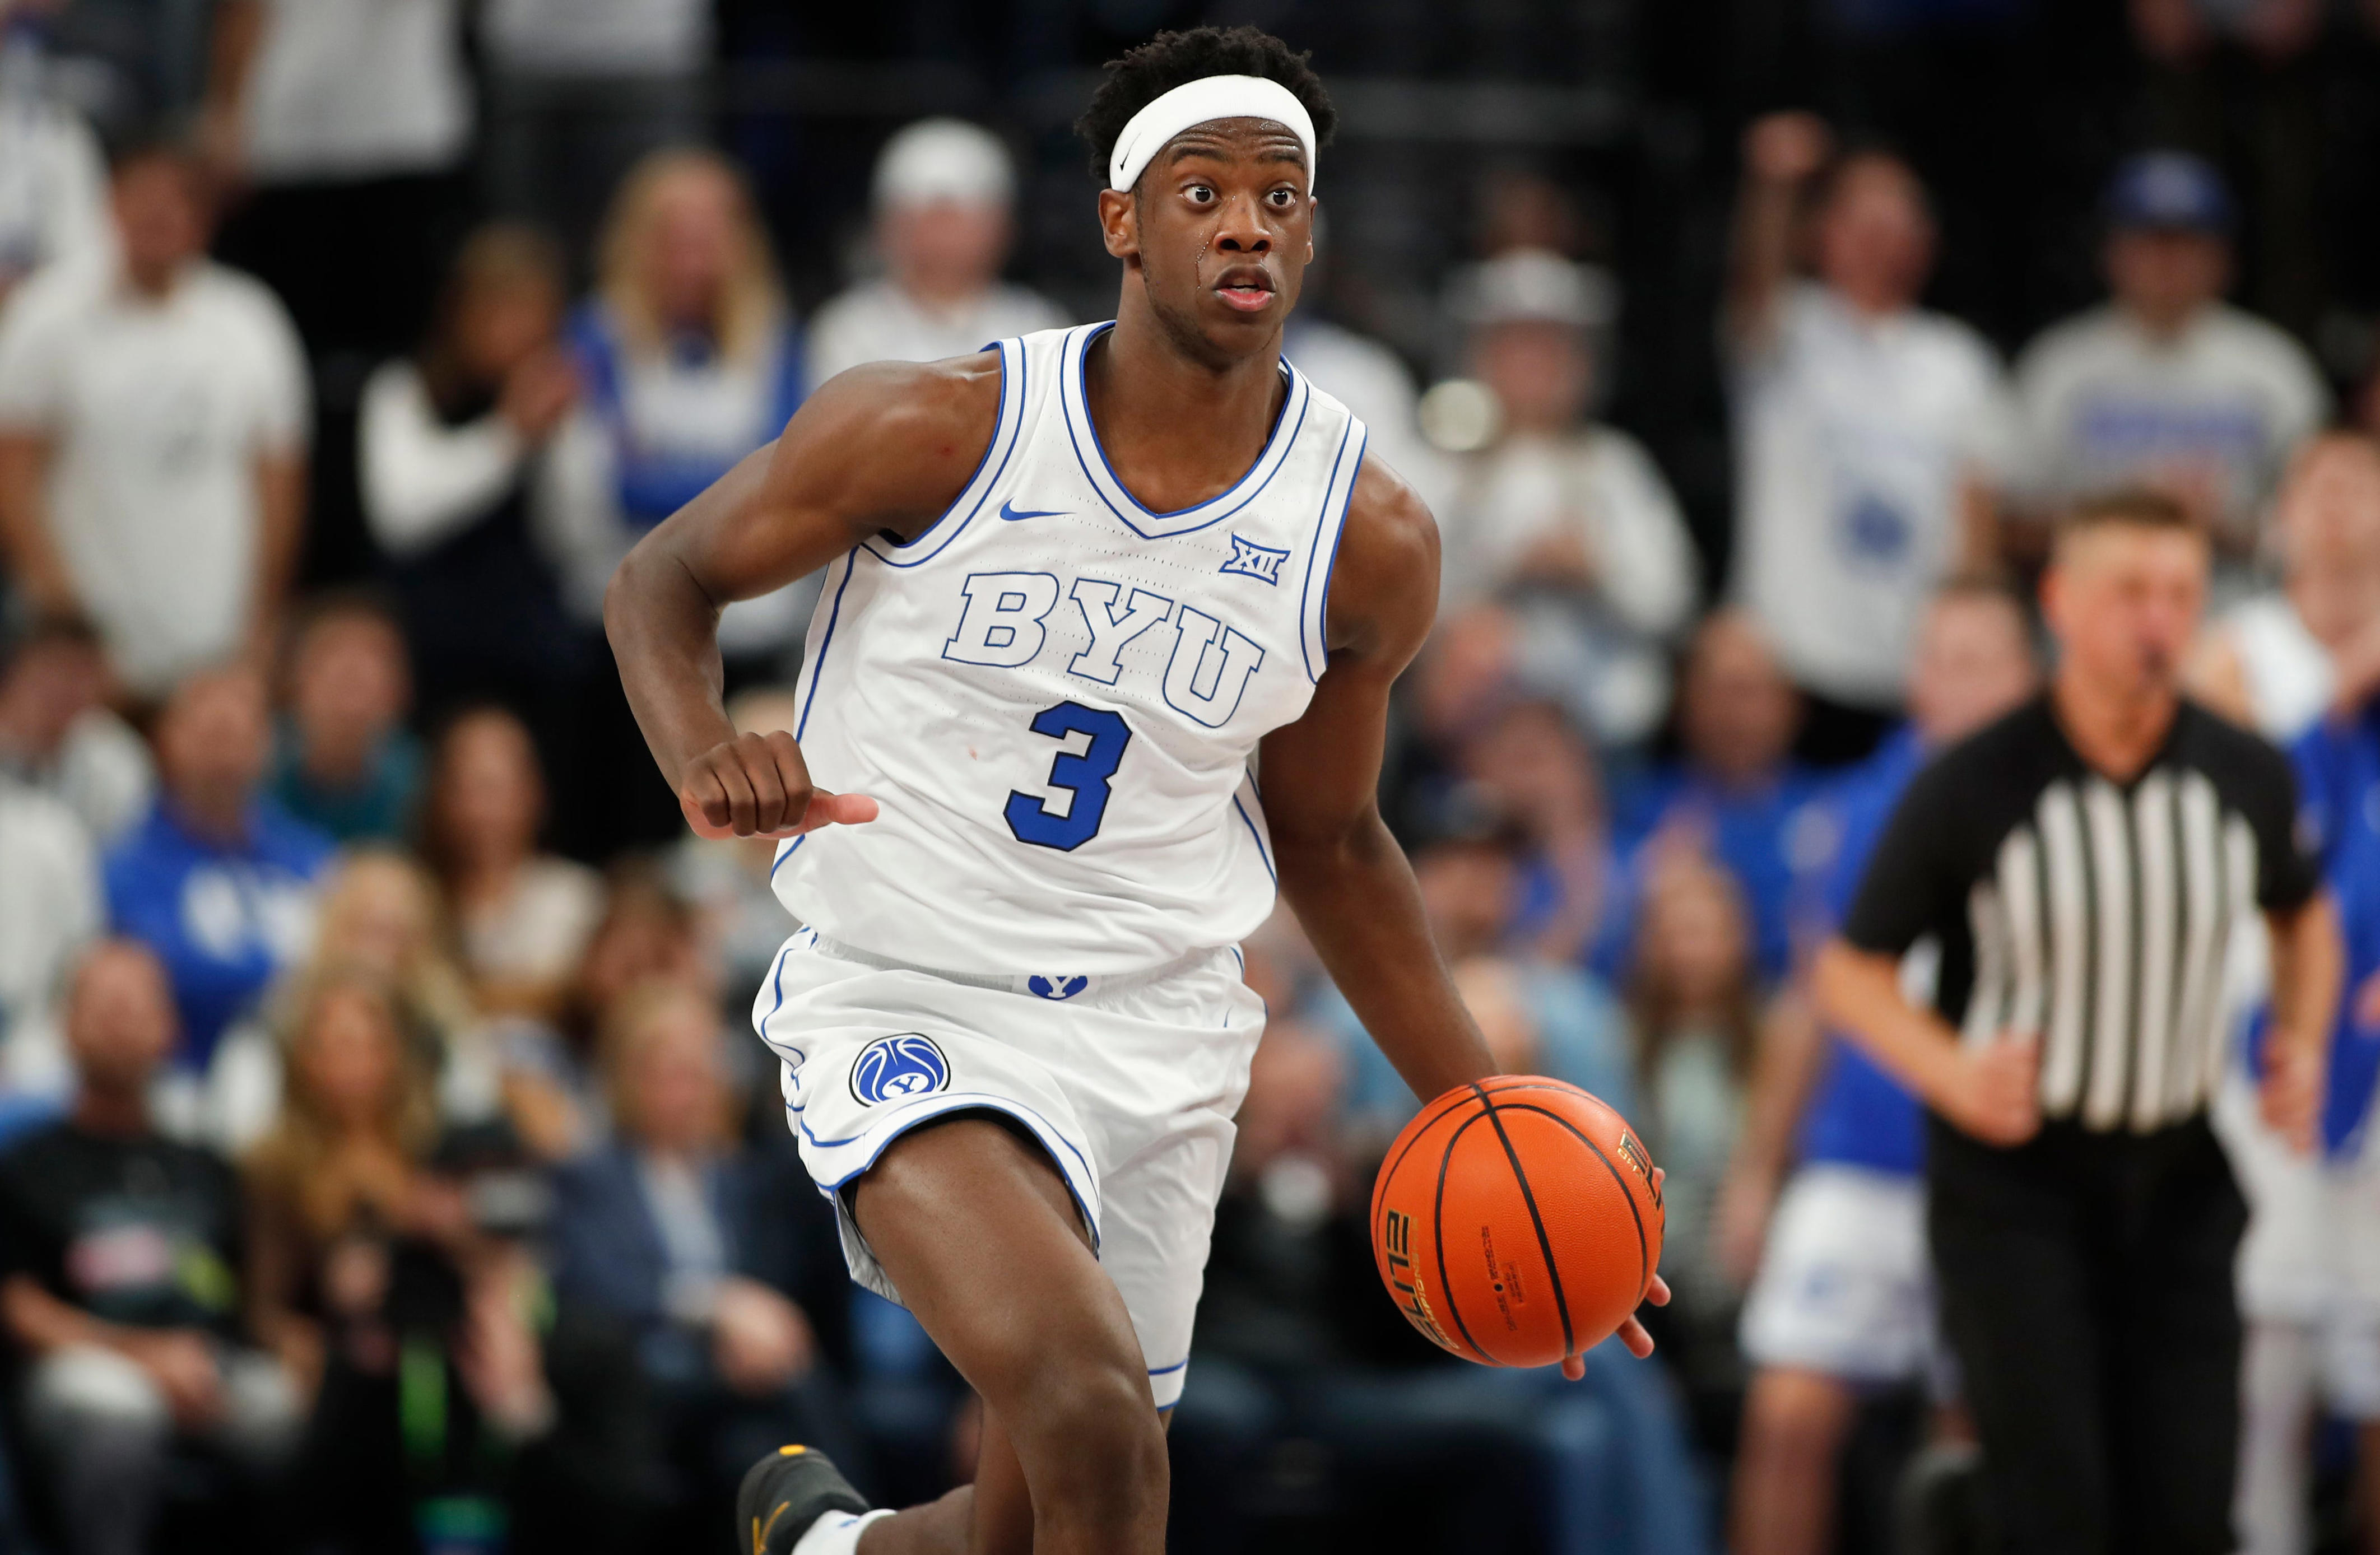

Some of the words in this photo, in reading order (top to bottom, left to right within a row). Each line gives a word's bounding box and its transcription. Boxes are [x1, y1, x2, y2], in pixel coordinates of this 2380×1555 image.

[1218, 532, 1291, 587] XII
[941, 571, 1266, 728] BYU
[1003, 700, 1132, 852] 3
[1039, 975, 1079, 998] Y
[889, 1076, 918, 1094] Y
